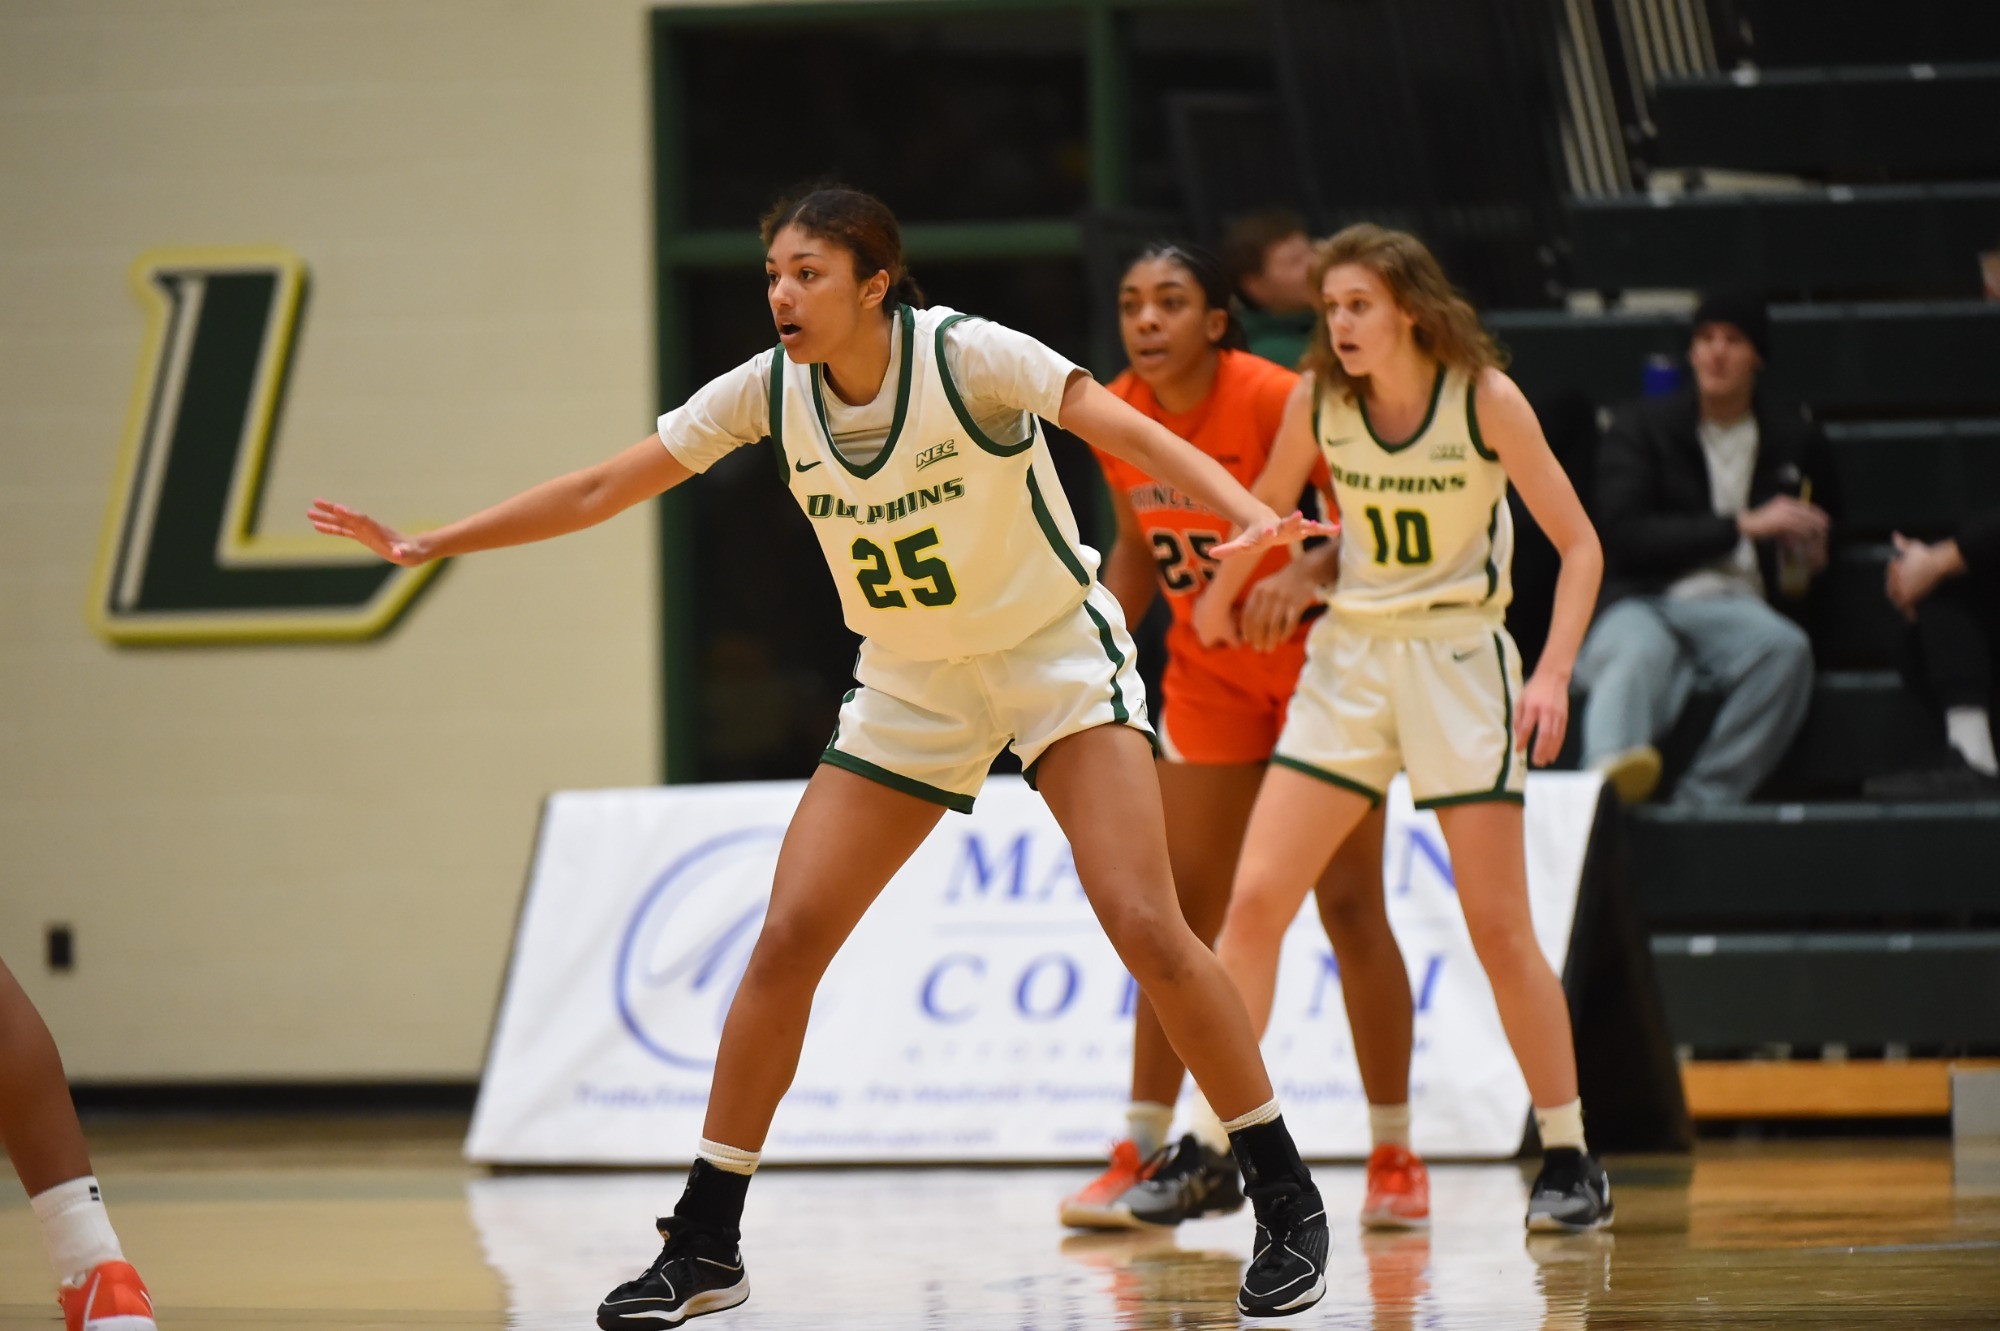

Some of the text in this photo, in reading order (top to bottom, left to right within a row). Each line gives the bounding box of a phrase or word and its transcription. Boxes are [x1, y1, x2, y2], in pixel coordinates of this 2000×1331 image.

[916, 439, 958, 471] NEC
[850, 524, 959, 609] 25
[1147, 528, 1223, 594] 25
[1364, 505, 1433, 566] 10
